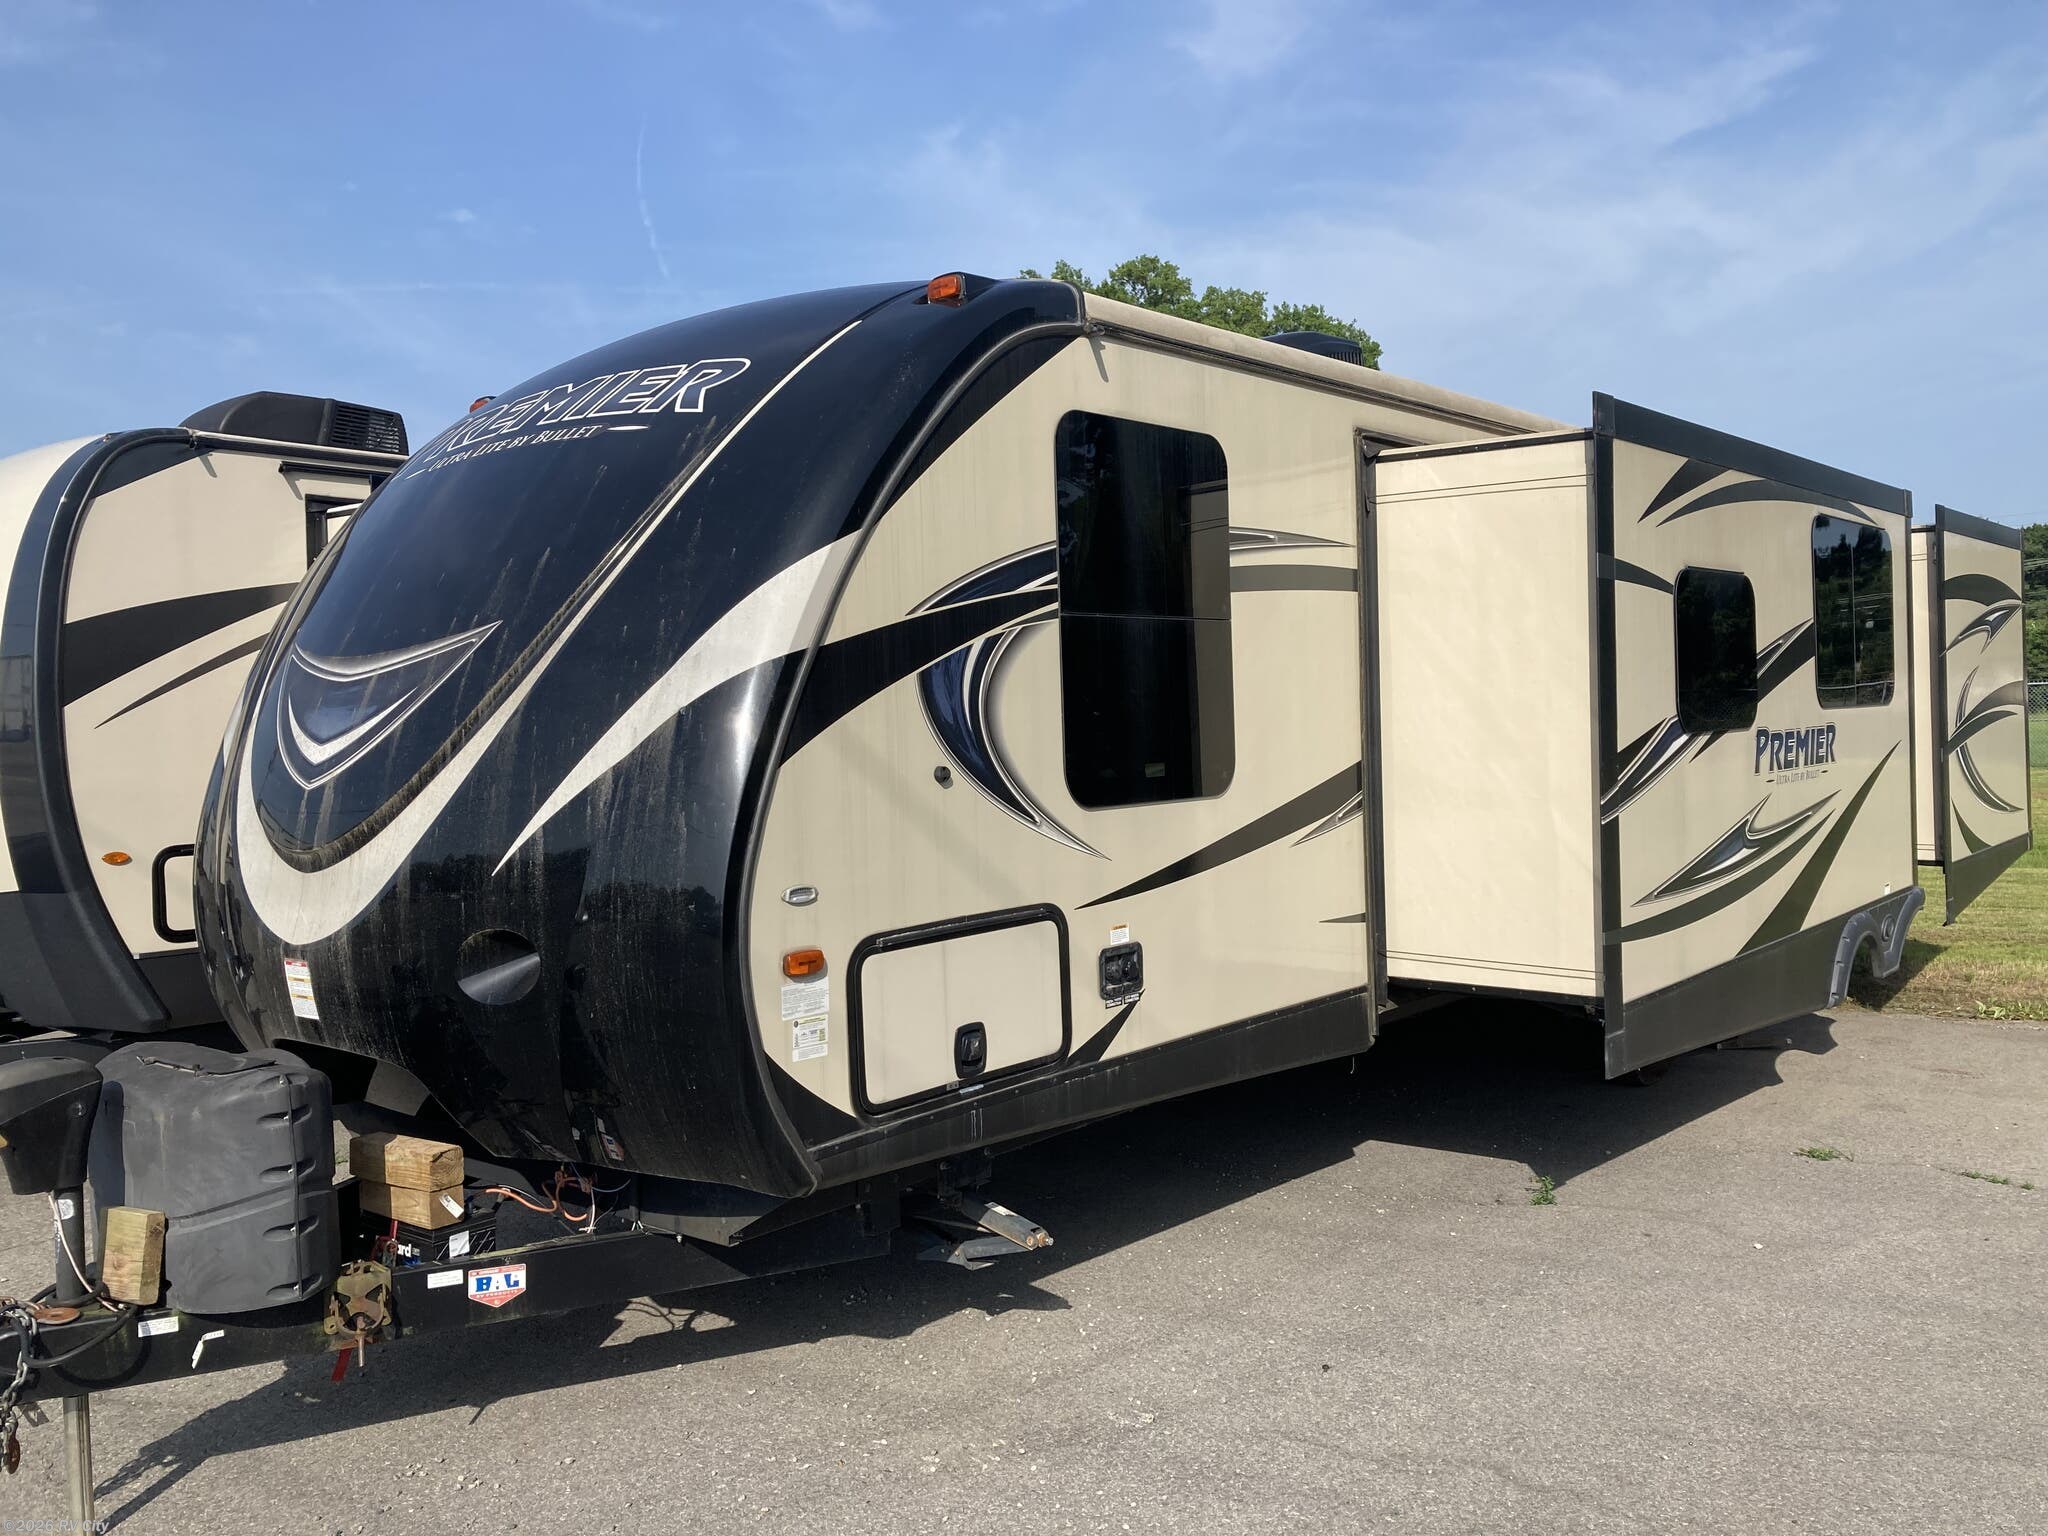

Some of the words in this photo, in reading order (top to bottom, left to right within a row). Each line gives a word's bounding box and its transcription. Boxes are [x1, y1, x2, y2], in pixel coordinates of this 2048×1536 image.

[428, 450, 473, 472] ULTRA
[471, 438, 512, 458] LITE
[506, 434, 536, 449] BY
[530, 424, 603, 445] BULLET
[1754, 721, 1837, 776] PREMIER
[475, 1272, 520, 1293] BAL
